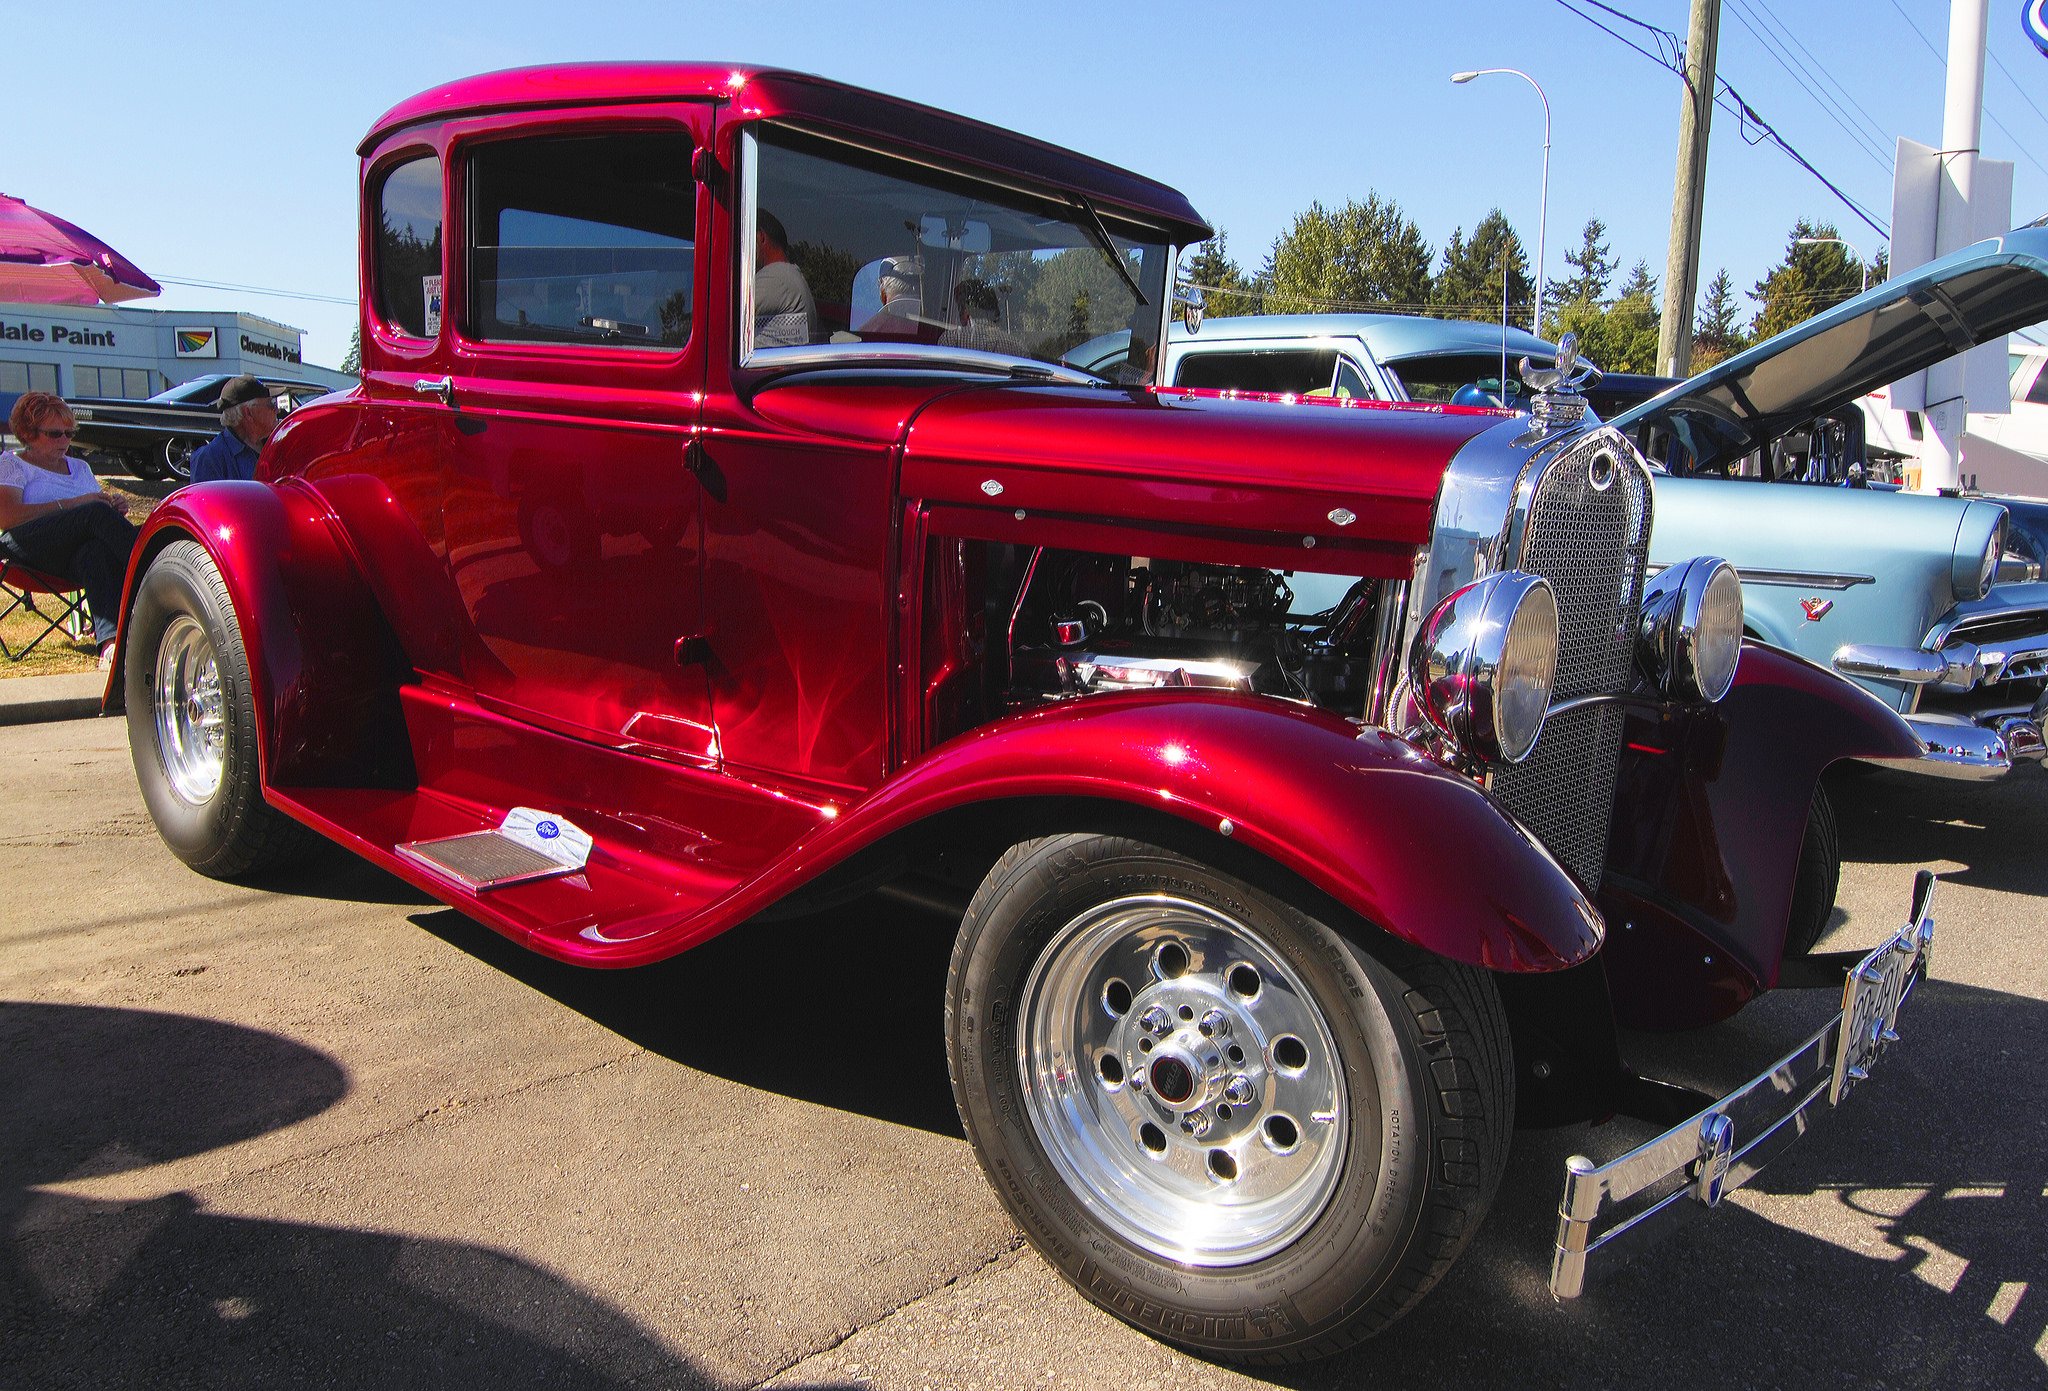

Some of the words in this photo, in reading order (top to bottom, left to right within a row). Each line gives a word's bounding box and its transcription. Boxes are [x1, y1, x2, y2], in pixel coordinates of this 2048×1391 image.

[51, 325, 116, 347] Paint
[240, 334, 282, 361] Cloverdale
[282, 346, 302, 365] Paint
[1160, 1062, 1179, 1095] WELD
[1390, 1109, 1400, 1164] ROTATION
[1090, 1272, 1247, 1339] MICHELIN
